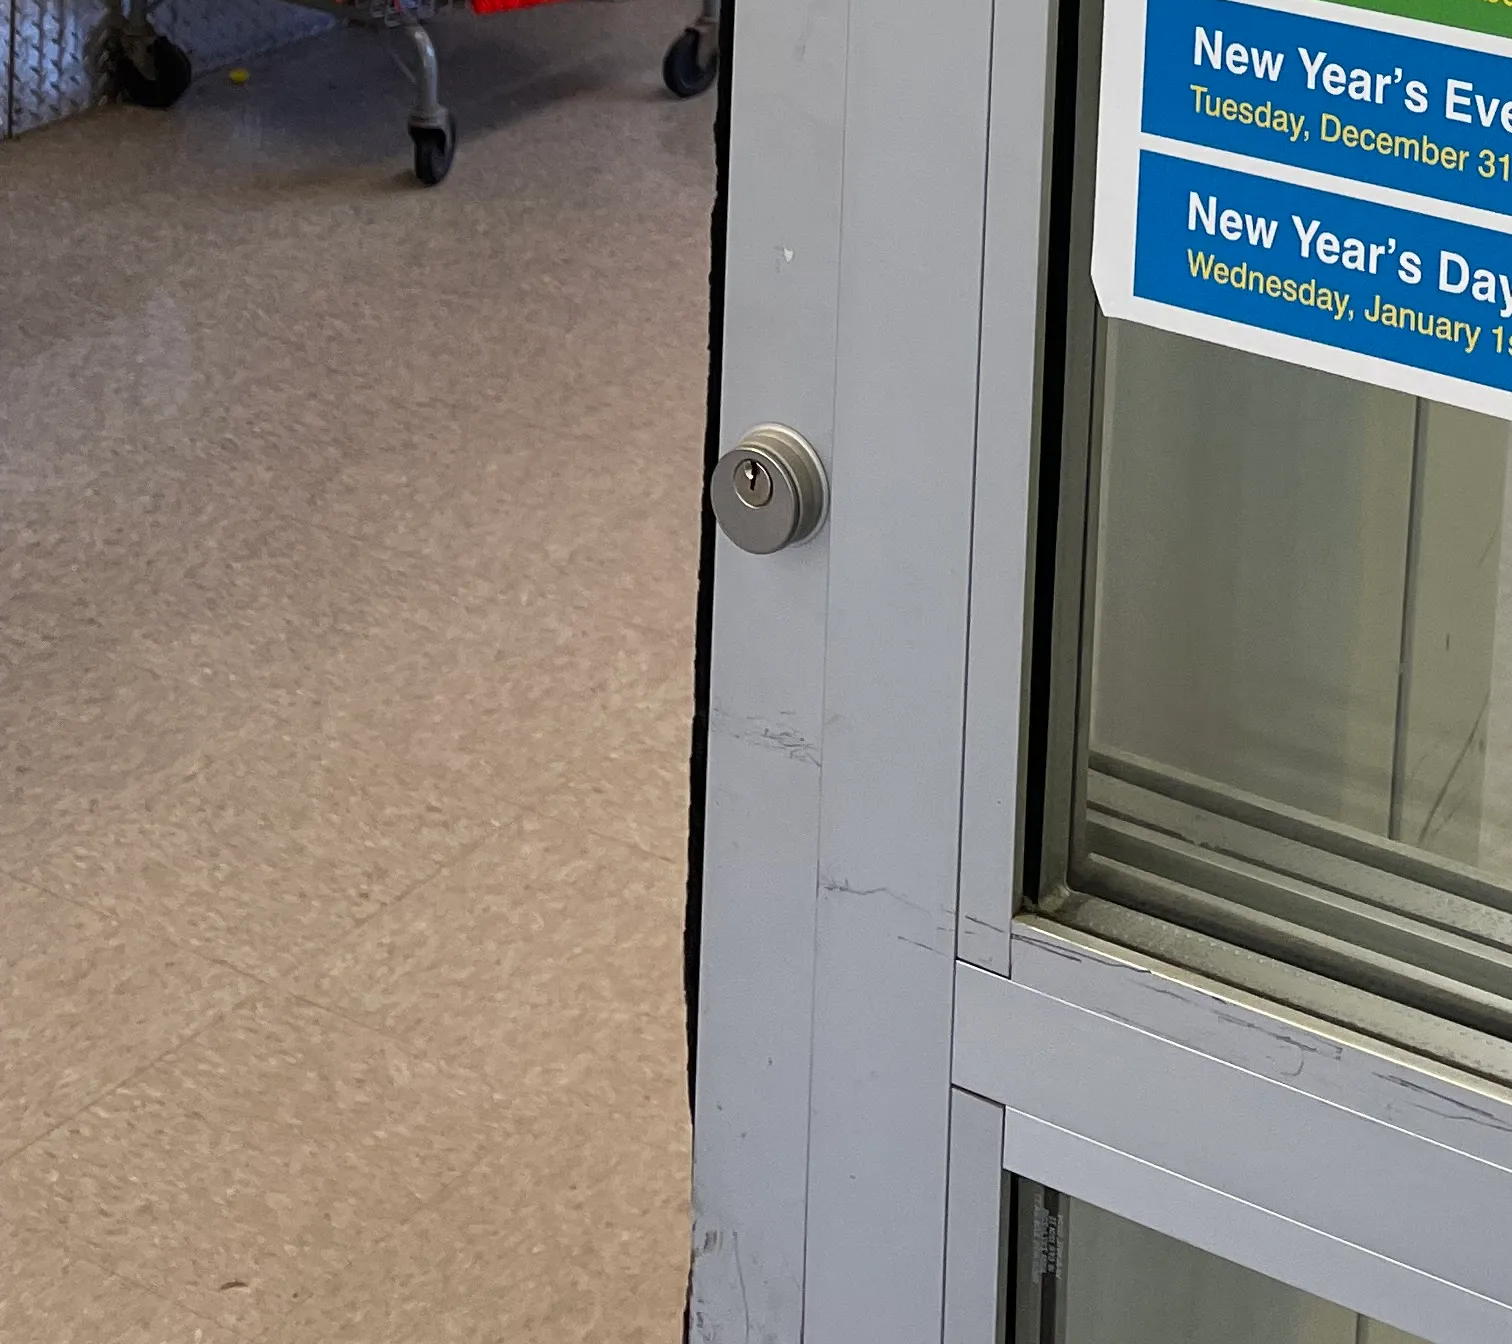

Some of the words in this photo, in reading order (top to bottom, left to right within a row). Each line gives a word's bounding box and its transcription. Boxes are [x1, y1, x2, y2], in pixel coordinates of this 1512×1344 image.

[1195, 27, 1284, 81] New
[1298, 48, 1427, 112] Year's
[1191, 85, 1311, 141] Tuesday,
[1321, 116, 1469, 170] December
[1189, 192, 1278, 248] New
[1292, 216, 1421, 283] Year's
[1188, 249, 1355, 320] Wednesday,
[1365, 295, 1481, 352] January
